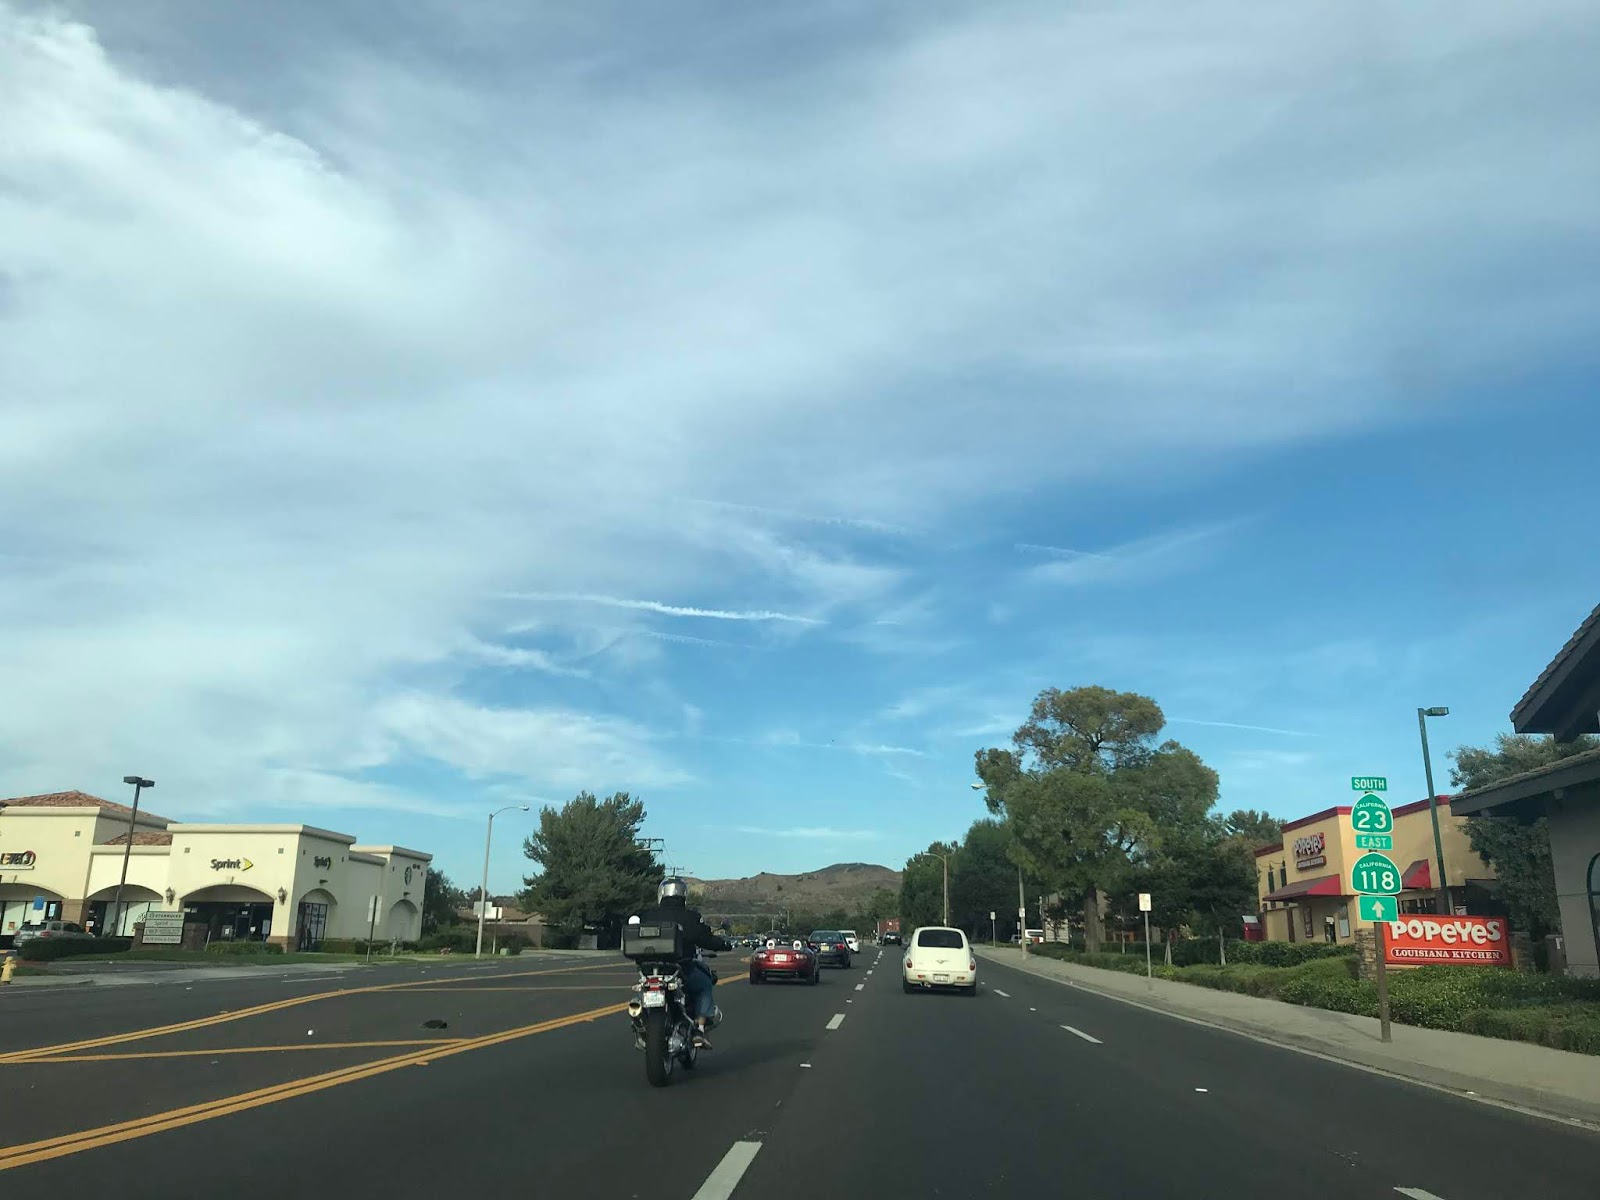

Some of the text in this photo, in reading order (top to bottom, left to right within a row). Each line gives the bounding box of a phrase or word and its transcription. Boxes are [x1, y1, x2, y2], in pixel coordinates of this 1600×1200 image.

[1354, 779, 1385, 789] SOUTH
[1355, 802, 1387, 811] CALIFORNIA
[1357, 810, 1387, 829] 23
[1361, 836, 1387, 848] EAST
[210, 858, 241, 871] Sprint
[1359, 861, 1392, 869] CALIFORNIA
[1361, 870, 1394, 890] 118
[1395, 949, 1500, 959] LOUISIANA KITCHEN
